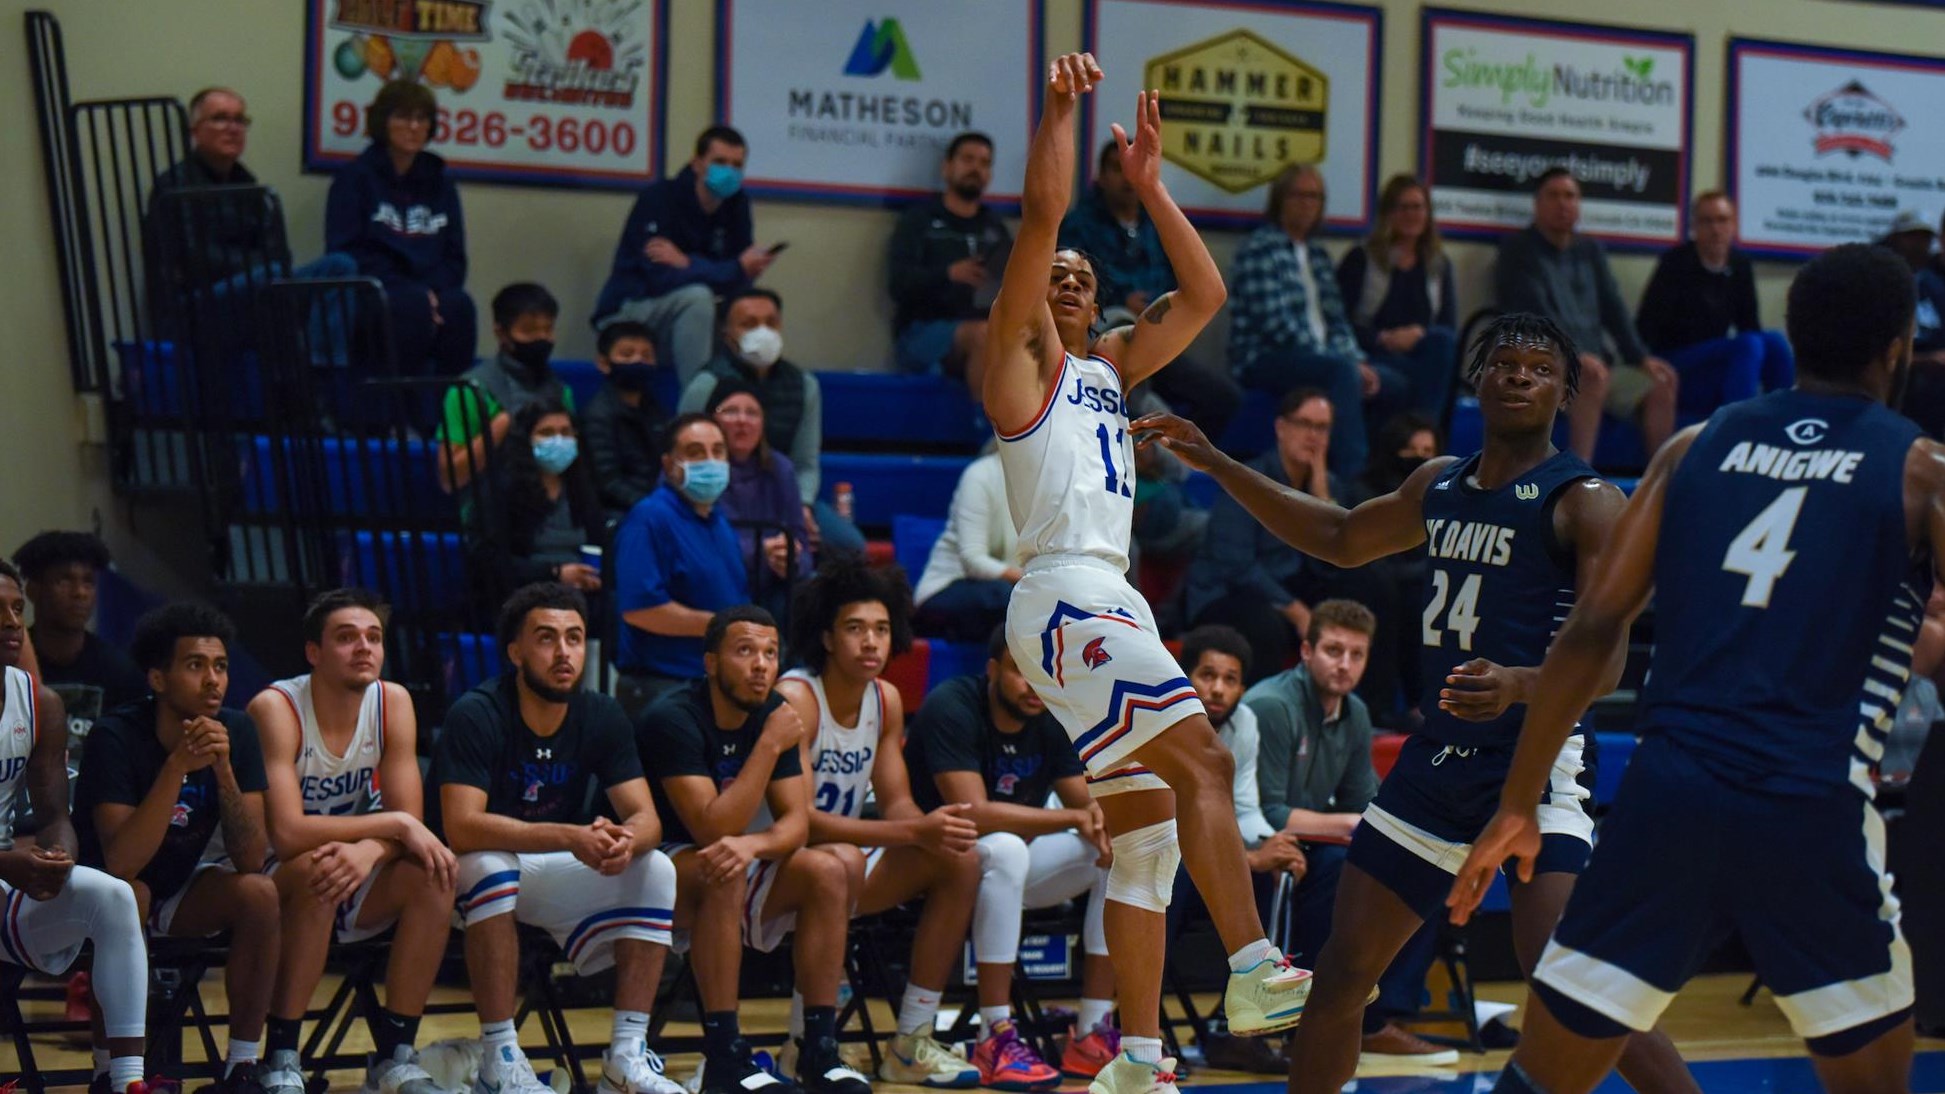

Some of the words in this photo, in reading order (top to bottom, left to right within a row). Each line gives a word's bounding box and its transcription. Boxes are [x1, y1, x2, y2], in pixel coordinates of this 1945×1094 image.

[416, 1, 479, 34] TIME
[1162, 65, 1314, 100] HAMMER
[331, 100, 637, 157] 9626-3600
[788, 89, 973, 128] MATHESON
[1183, 131, 1290, 161] NAILS
[1463, 142, 1651, 193] #seeyotsimply
[1067, 378, 1129, 418] JSSU
[1718, 441, 1865, 484] ANIGWE
[1439, 520, 1516, 567] DAVIS
[1721, 485, 1799, 609] 4
[1422, 569, 1483, 651] 24
[815, 781, 856, 817] 21
